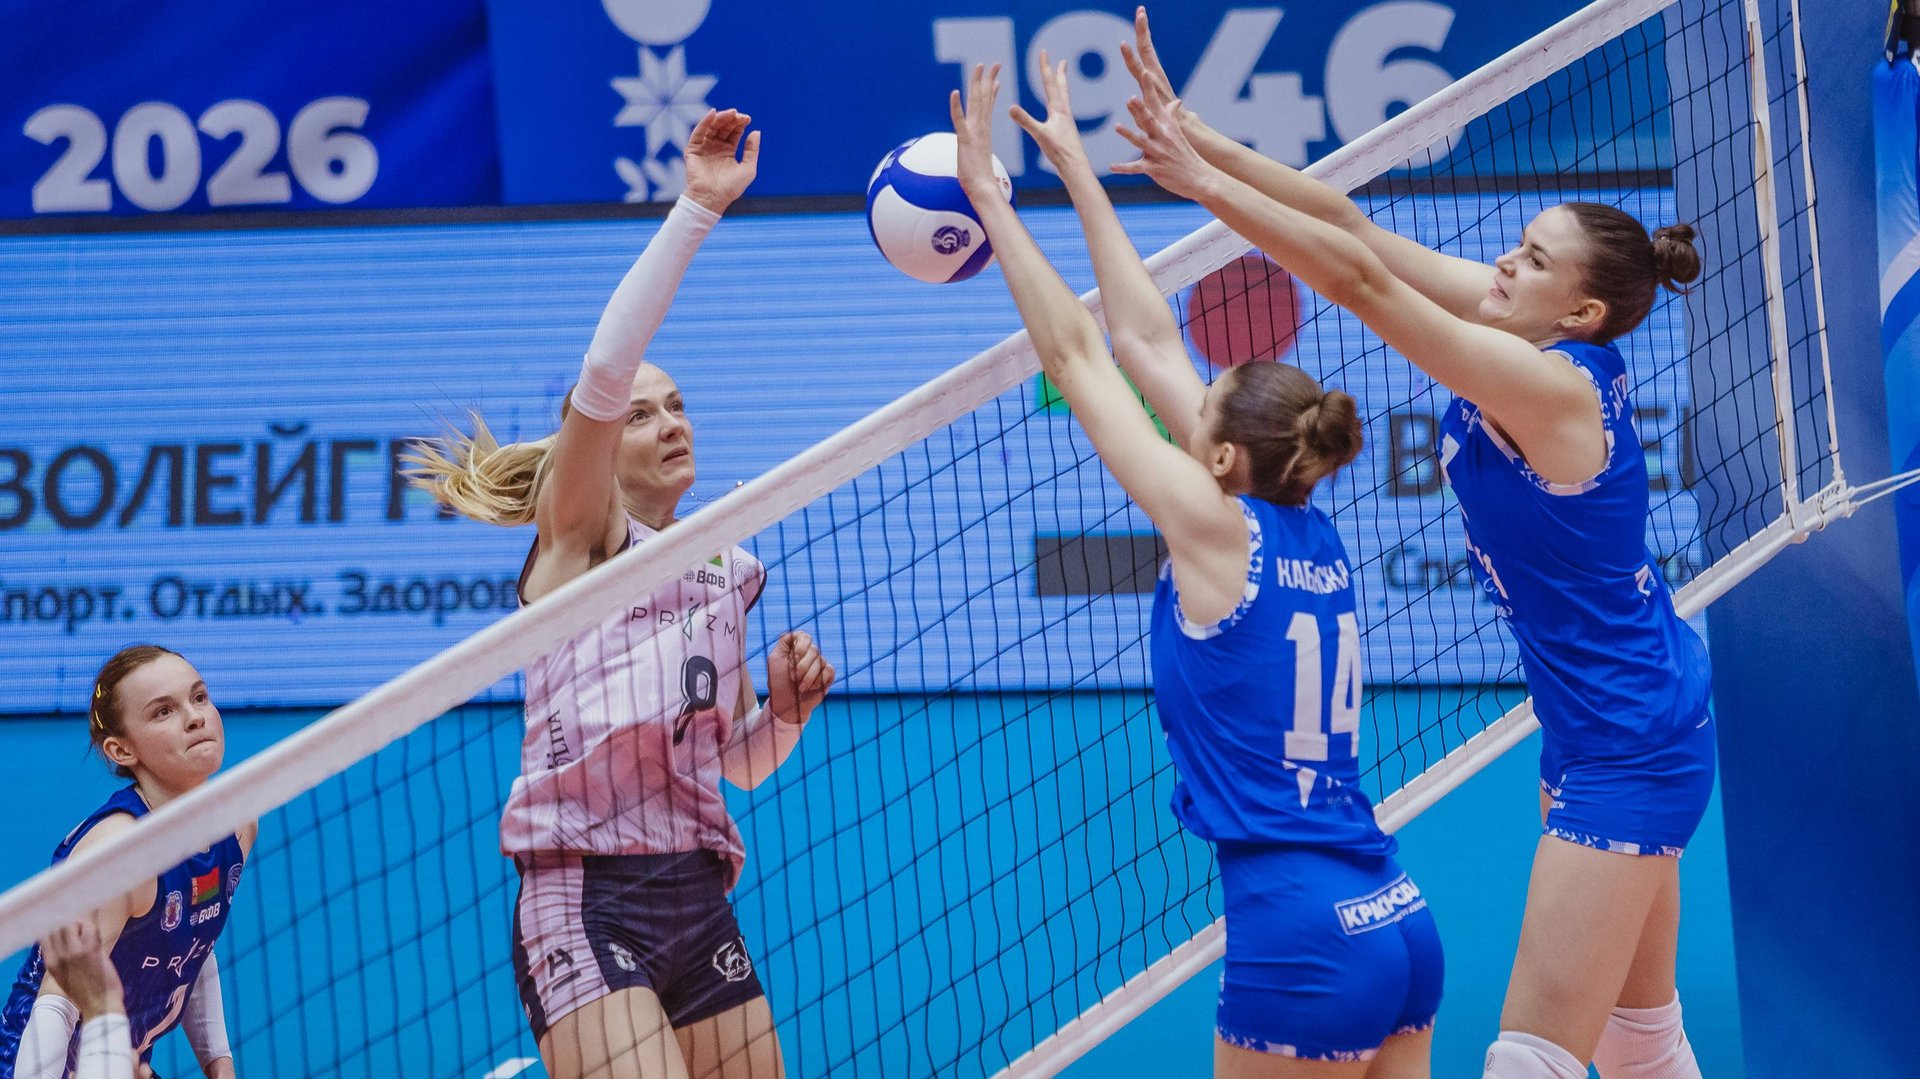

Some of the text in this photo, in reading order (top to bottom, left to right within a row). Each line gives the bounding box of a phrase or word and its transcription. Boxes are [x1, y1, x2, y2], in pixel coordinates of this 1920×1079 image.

[23, 97, 379, 214] 2026
[933, 3, 1456, 176] 1946
[0, 584, 135, 636] порт.
[1283, 610, 1361, 762] 14
